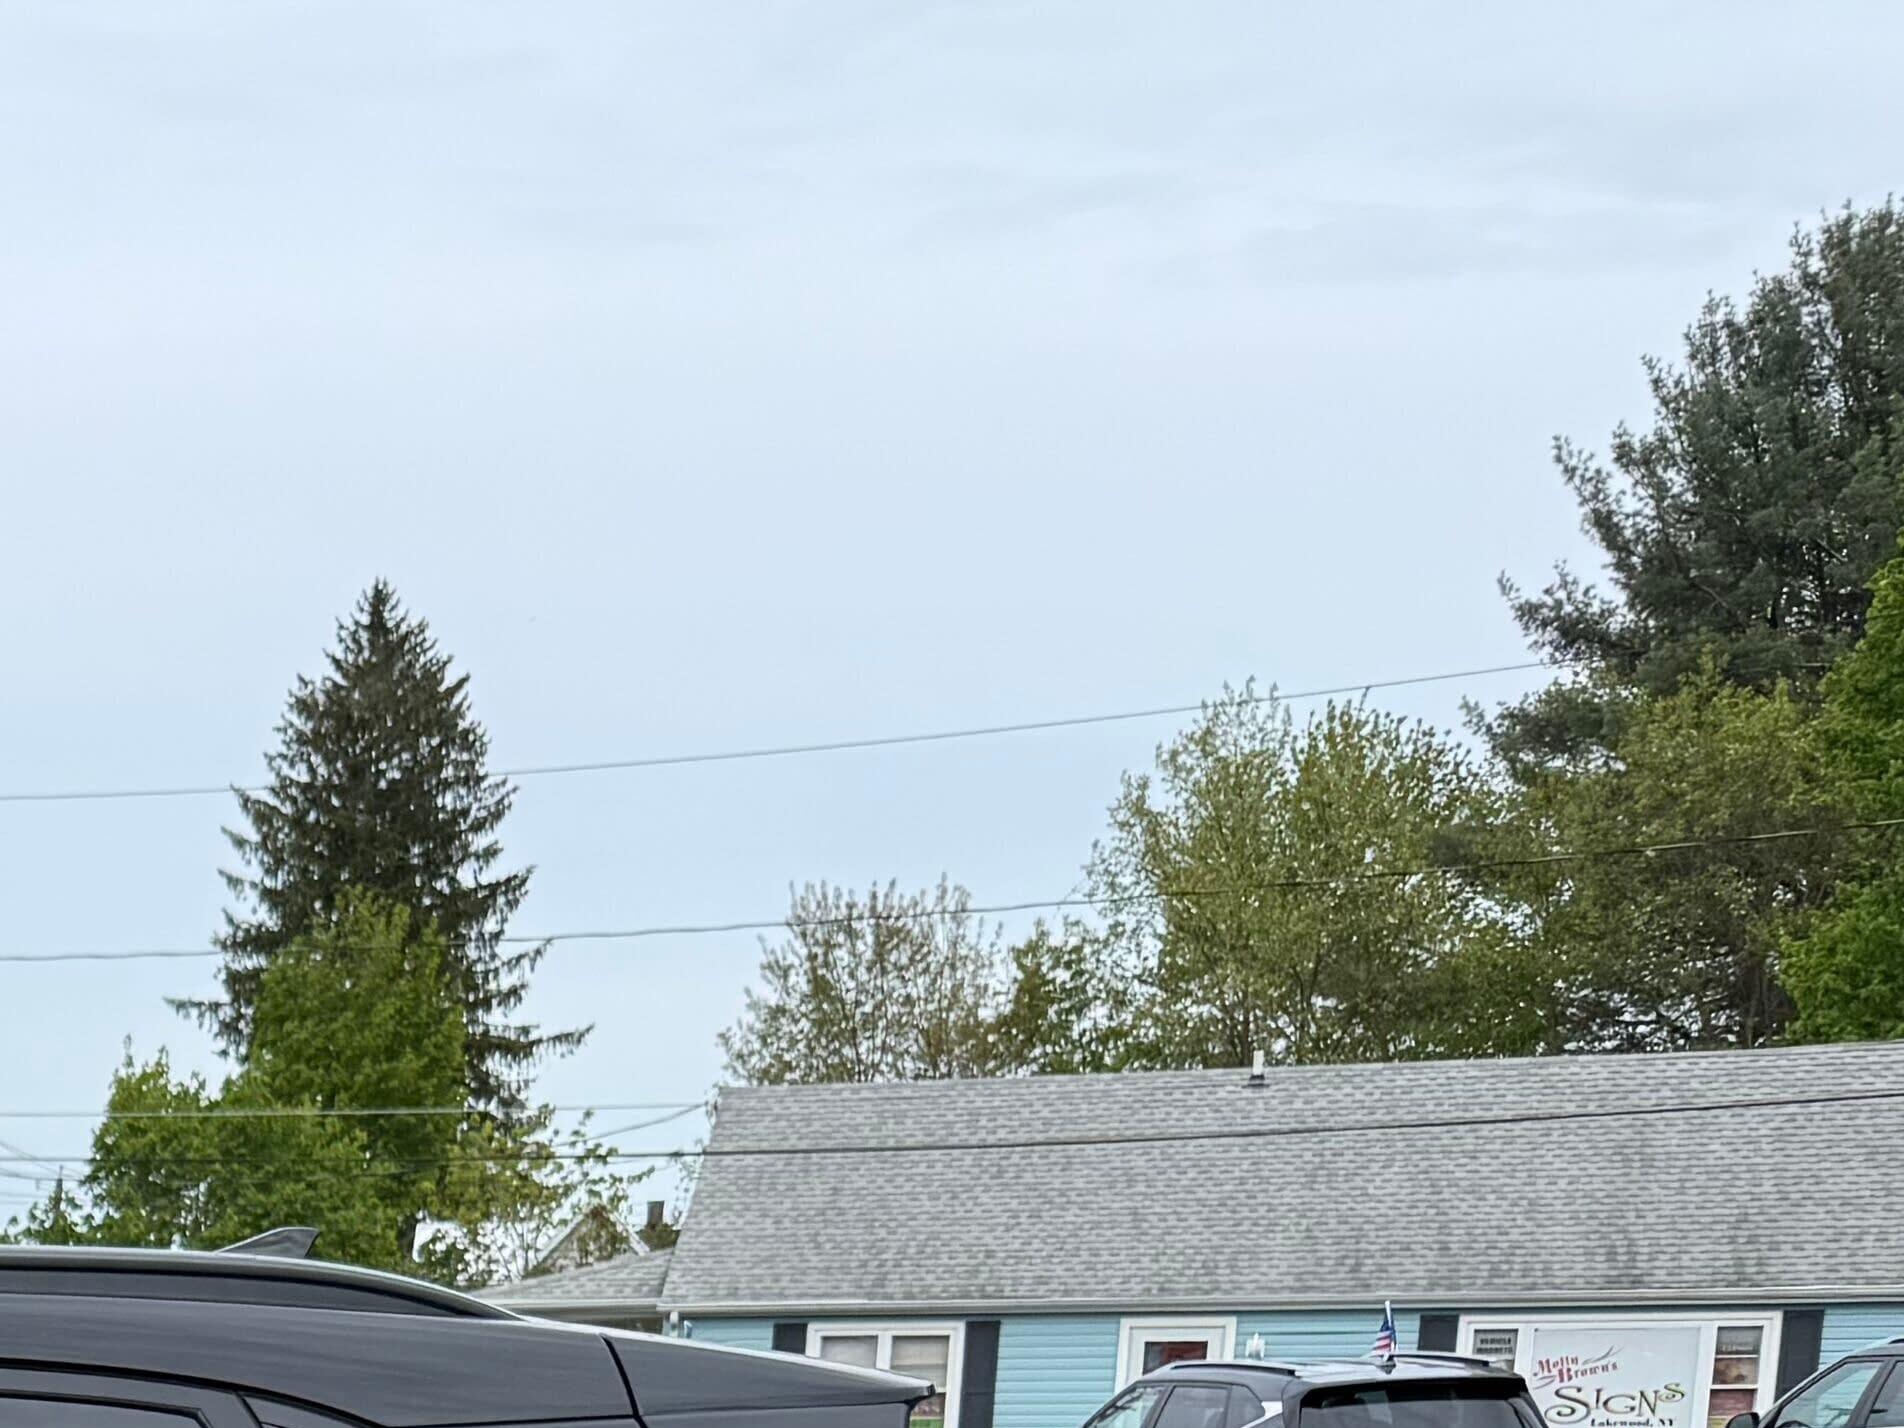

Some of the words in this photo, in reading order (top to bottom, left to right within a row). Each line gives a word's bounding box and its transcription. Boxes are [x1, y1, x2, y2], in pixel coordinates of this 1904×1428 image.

[1533, 1355, 1579, 1377] Molly
[1558, 1361, 1618, 1383] Brown's
[1544, 1382, 1685, 1425] SIGNS
[1591, 1417, 1654, 1428] Lakewood,
